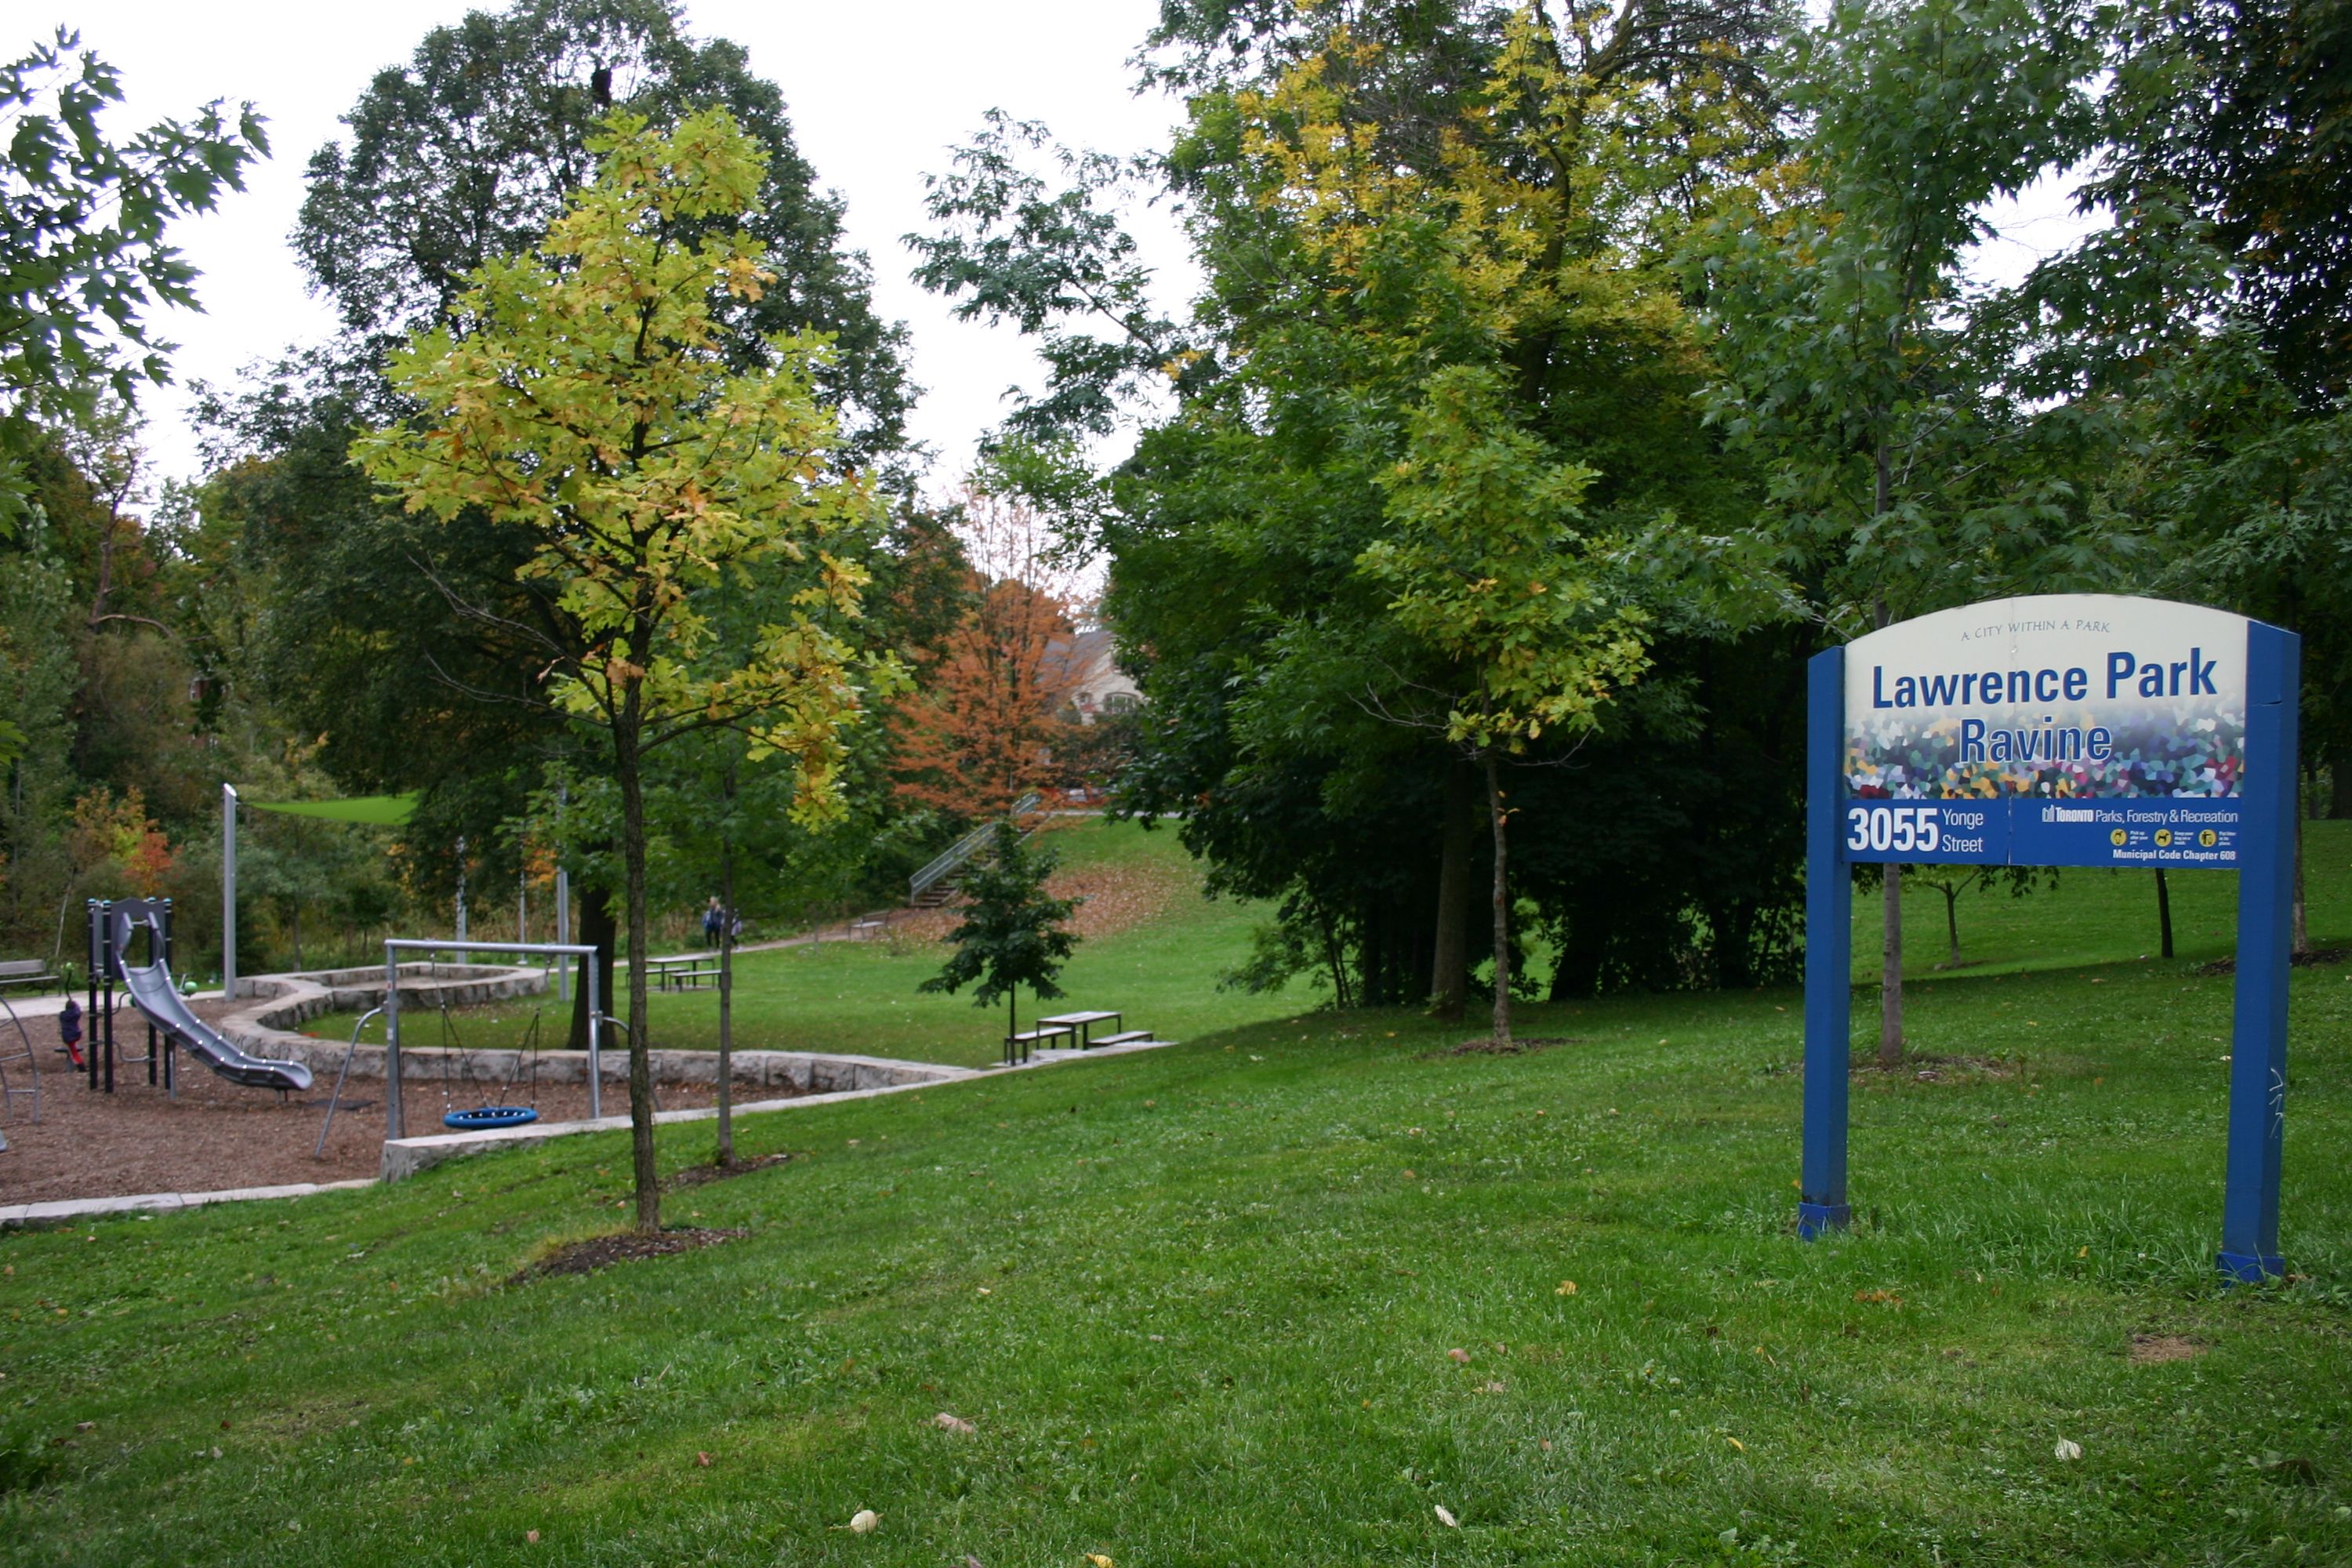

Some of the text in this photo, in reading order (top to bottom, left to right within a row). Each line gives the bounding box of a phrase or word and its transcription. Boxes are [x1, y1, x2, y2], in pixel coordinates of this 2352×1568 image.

[1961, 619, 2111, 641] A CITY WITHIN A PARK
[1872, 647, 2218, 709] Lawrence Park
[1959, 715, 2112, 764] Ravine
[1942, 808, 1984, 830] Yonge
[2055, 807, 2238, 826] TORONTO Parks, Forestry & Recreation
[1847, 807, 1938, 852] 3055
[1941, 834, 1984, 853] Street
[2113, 849, 2237, 862] Municipal Code Chapter 608
